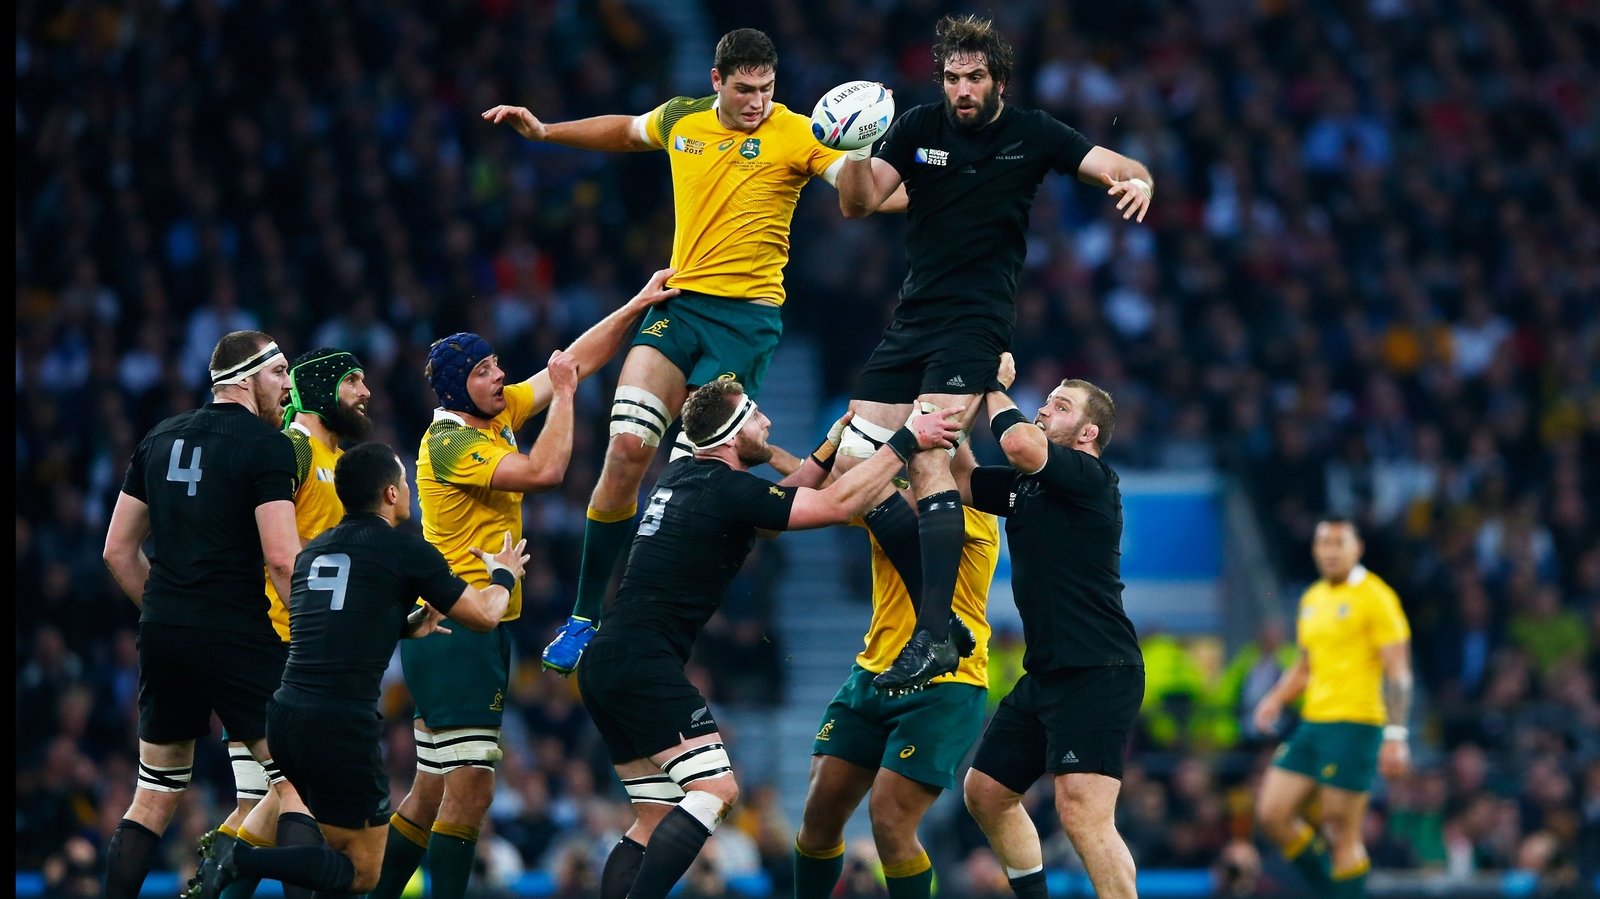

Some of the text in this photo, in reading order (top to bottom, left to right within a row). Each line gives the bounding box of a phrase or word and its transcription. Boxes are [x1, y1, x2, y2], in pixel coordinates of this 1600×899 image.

[858, 121, 878, 132] 2015
[858, 131, 877, 141] RUGBY
[687, 138, 706, 147] RUGBY
[684, 146, 703, 156] 2015
[929, 149, 949, 157] RUGBY
[928, 158, 947, 166] 2015
[166, 438, 203, 497] 4
[636, 487, 673, 537] 8
[307, 553, 351, 611] 9
